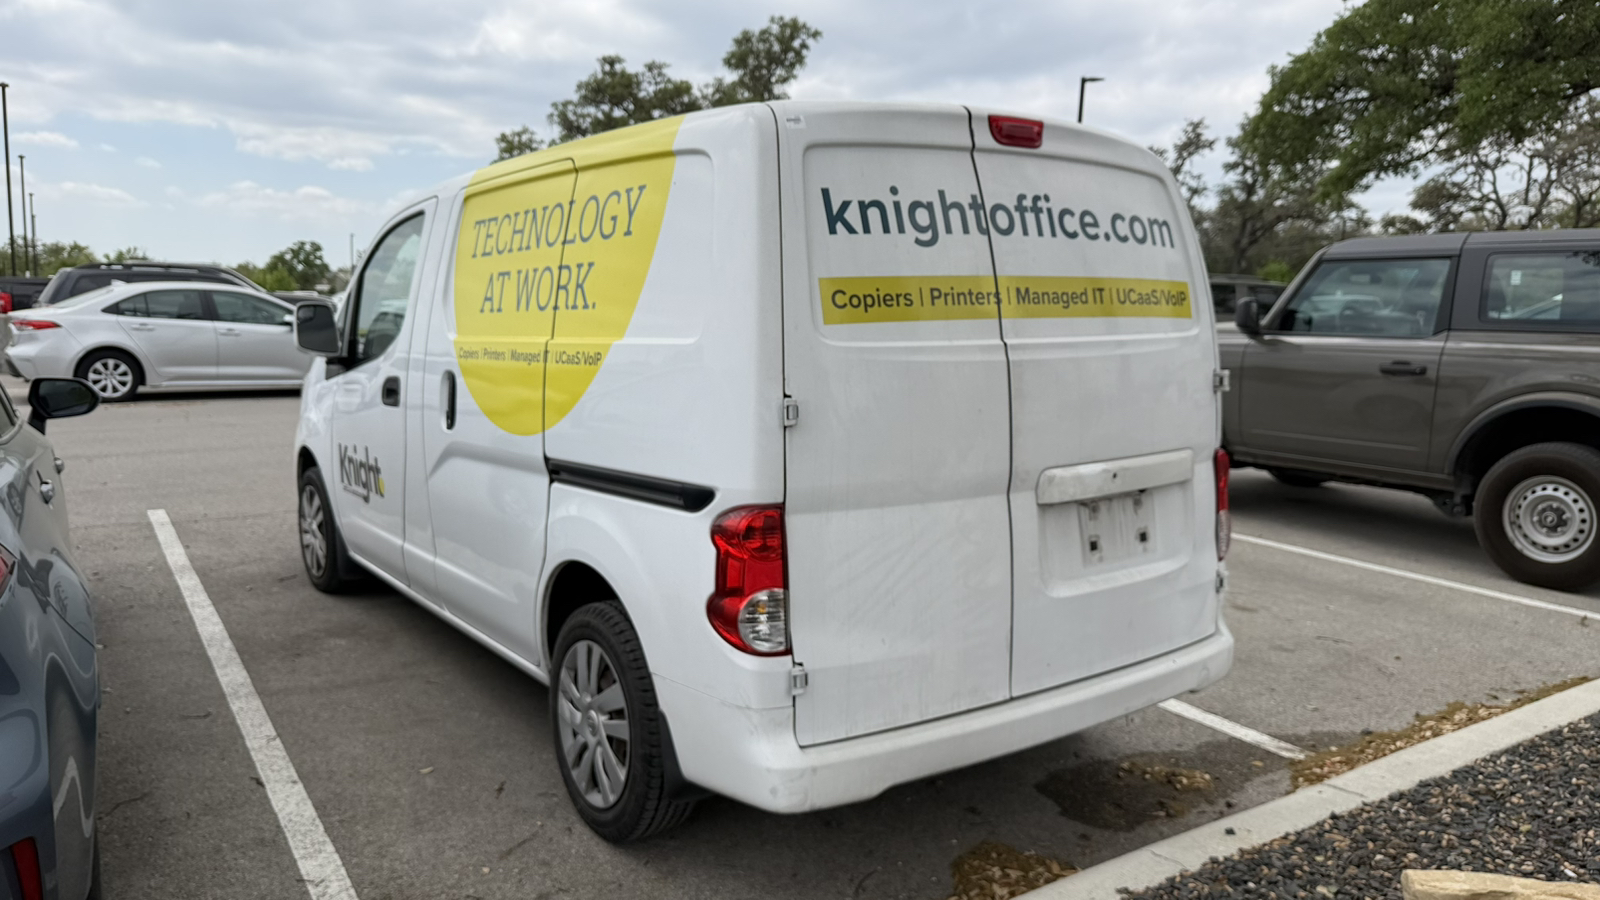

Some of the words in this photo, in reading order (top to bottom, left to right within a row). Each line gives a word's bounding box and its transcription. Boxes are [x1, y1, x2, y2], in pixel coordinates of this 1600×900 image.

[472, 184, 647, 258] TECHNOLOGY
[820, 185, 1175, 248] knightoffice.com
[480, 271, 511, 313] AT
[516, 262, 596, 311] WORK.
[831, 288, 914, 313] Copiers
[929, 286, 1002, 307] Printers
[1015, 286, 1089, 309] Managed
[1092, 287, 1105, 305] IT
[1116, 288, 1187, 307] UCaaS/VoIP
[459, 346, 479, 361] Copiers
[483, 346, 506, 361] Printers
[510, 349, 541, 366] Managed
[555, 350, 602, 366] UCaaS/VoIP
[338, 442, 384, 504] Knight
